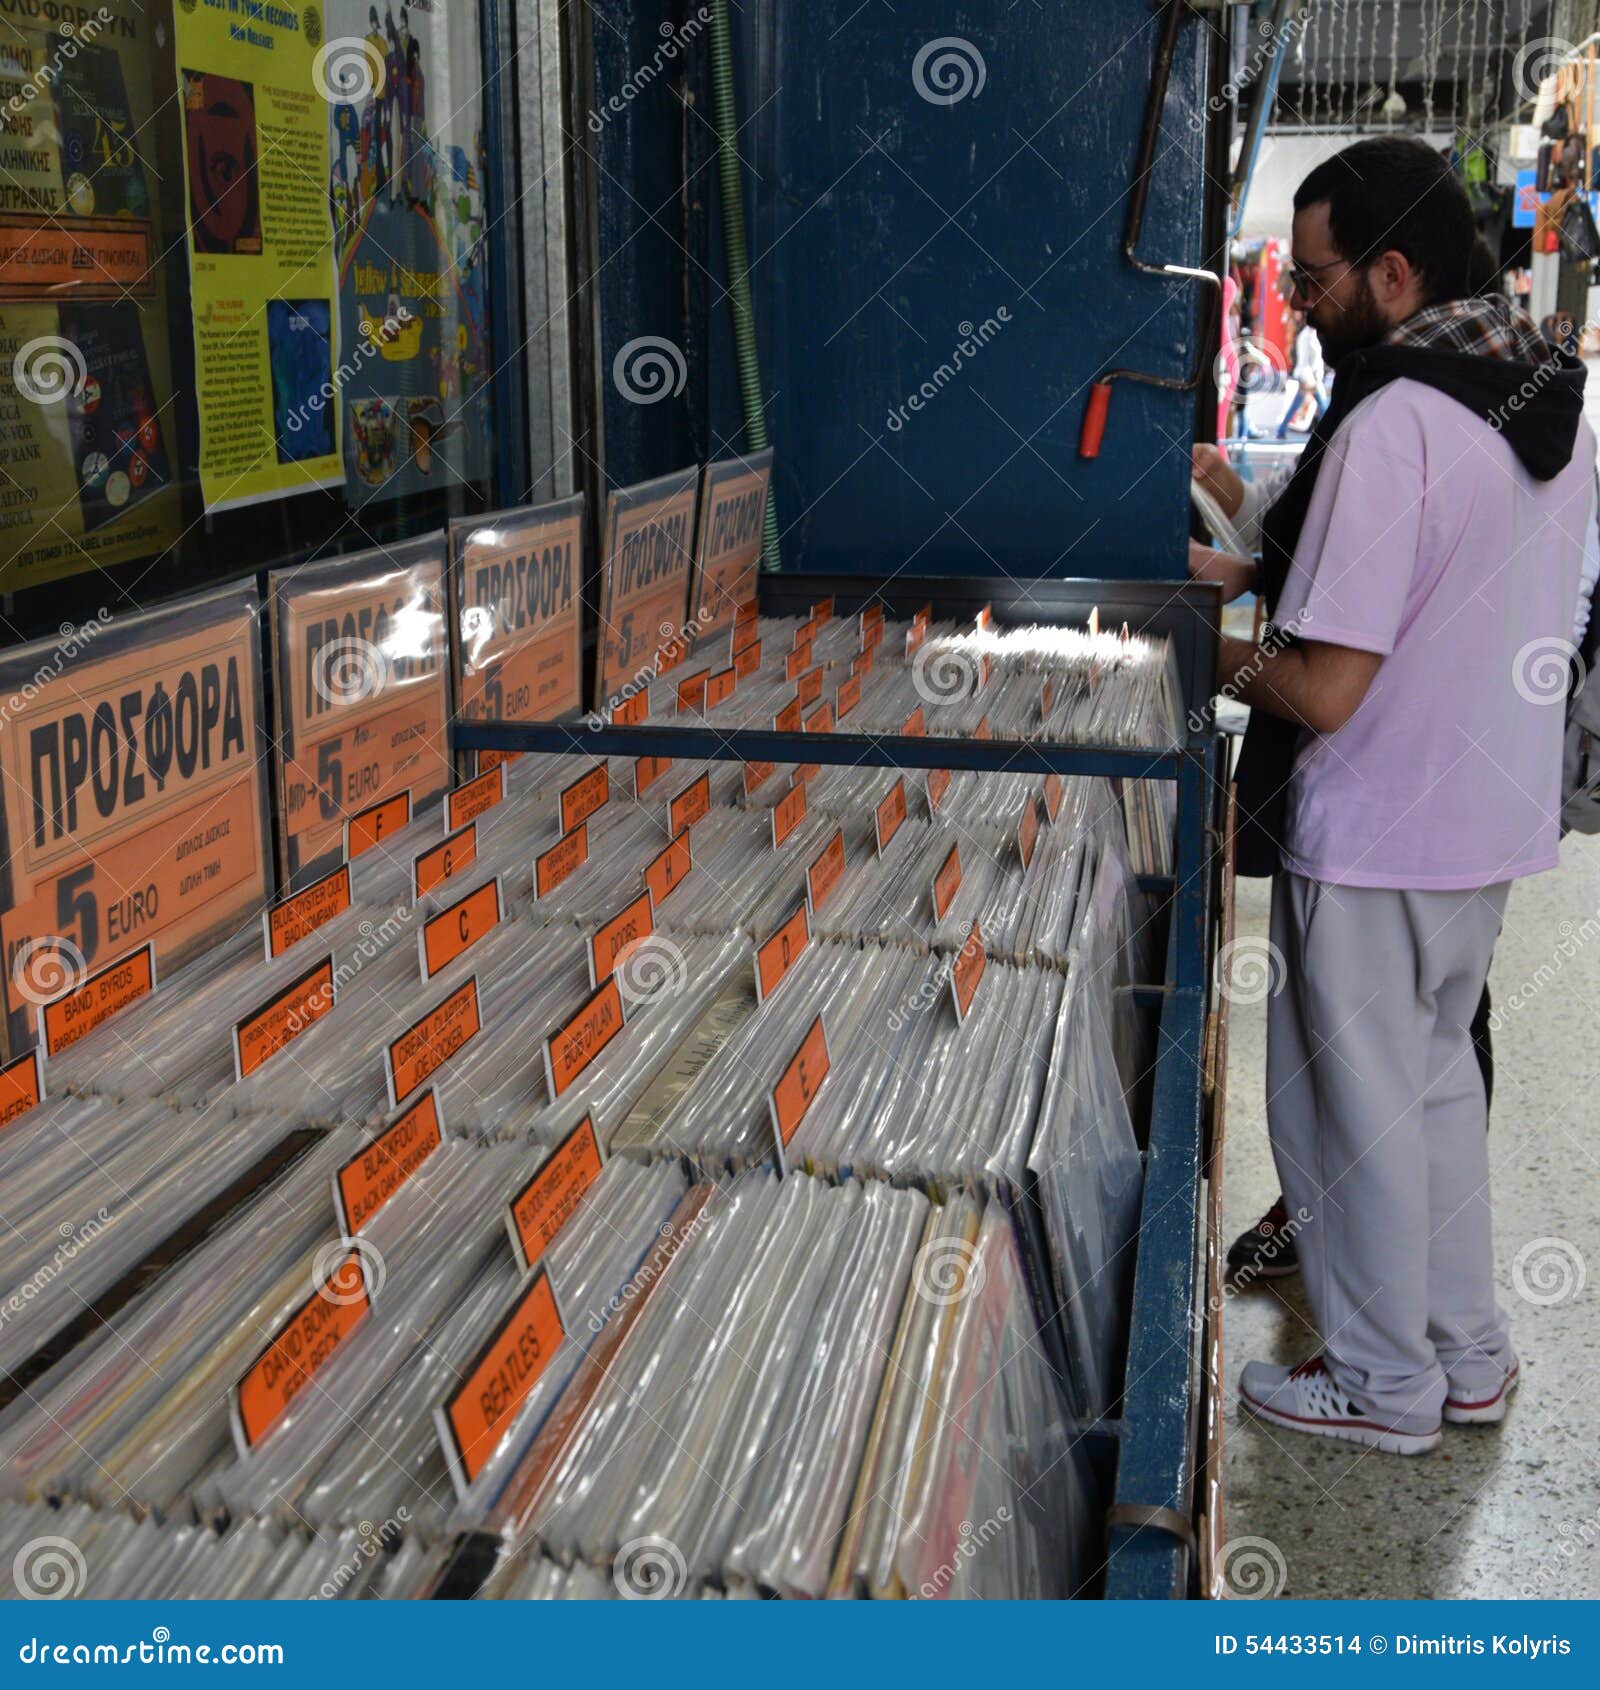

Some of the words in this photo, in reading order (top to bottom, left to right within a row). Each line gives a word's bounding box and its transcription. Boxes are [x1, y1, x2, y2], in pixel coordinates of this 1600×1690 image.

[266, 5, 300, 32] RECORDS
[72, 247, 94, 266] ΔΕΝ
[306, 590, 438, 719] ΠΡΟΣΦ
[506, 684, 531, 717] EURO
[30, 655, 244, 848] ΠΡΟΣΦΟΡΑ
[318, 736, 344, 821] 5
[348, 762, 380, 803] EURO
[375, 812, 384, 842] F
[443, 849, 452, 879] G
[664, 853, 673, 887] H
[57, 863, 99, 969] 5
[108, 883, 159, 943] EURO
[272, 903, 293, 930] BLUE
[328, 871, 346, 897] CULT
[302, 901, 339, 938] COMPANY
[458, 908, 469, 943] C
[782, 935, 790, 970] D
[64, 990, 93, 1022] BAND
[100, 966, 133, 1002] BYRDS
[53, 1022, 89, 1055] BARCLAY
[398, 1026, 429, 1067] CREAM
[562, 1030, 585, 1072] BOB
[583, 1001, 614, 1051] DYLAN
[414, 1052, 430, 1085] JOE
[799, 1060, 810, 1101] E
[363, 1114, 419, 1182] BLACKFOOT
[353, 1184, 379, 1225] BLACK
[379, 1170, 397, 1199] OAK
[398, 1131, 437, 1180] ARKANSAS
[263, 1326, 303, 1391] DAVID
[480, 1323, 542, 1430] BEATLES
